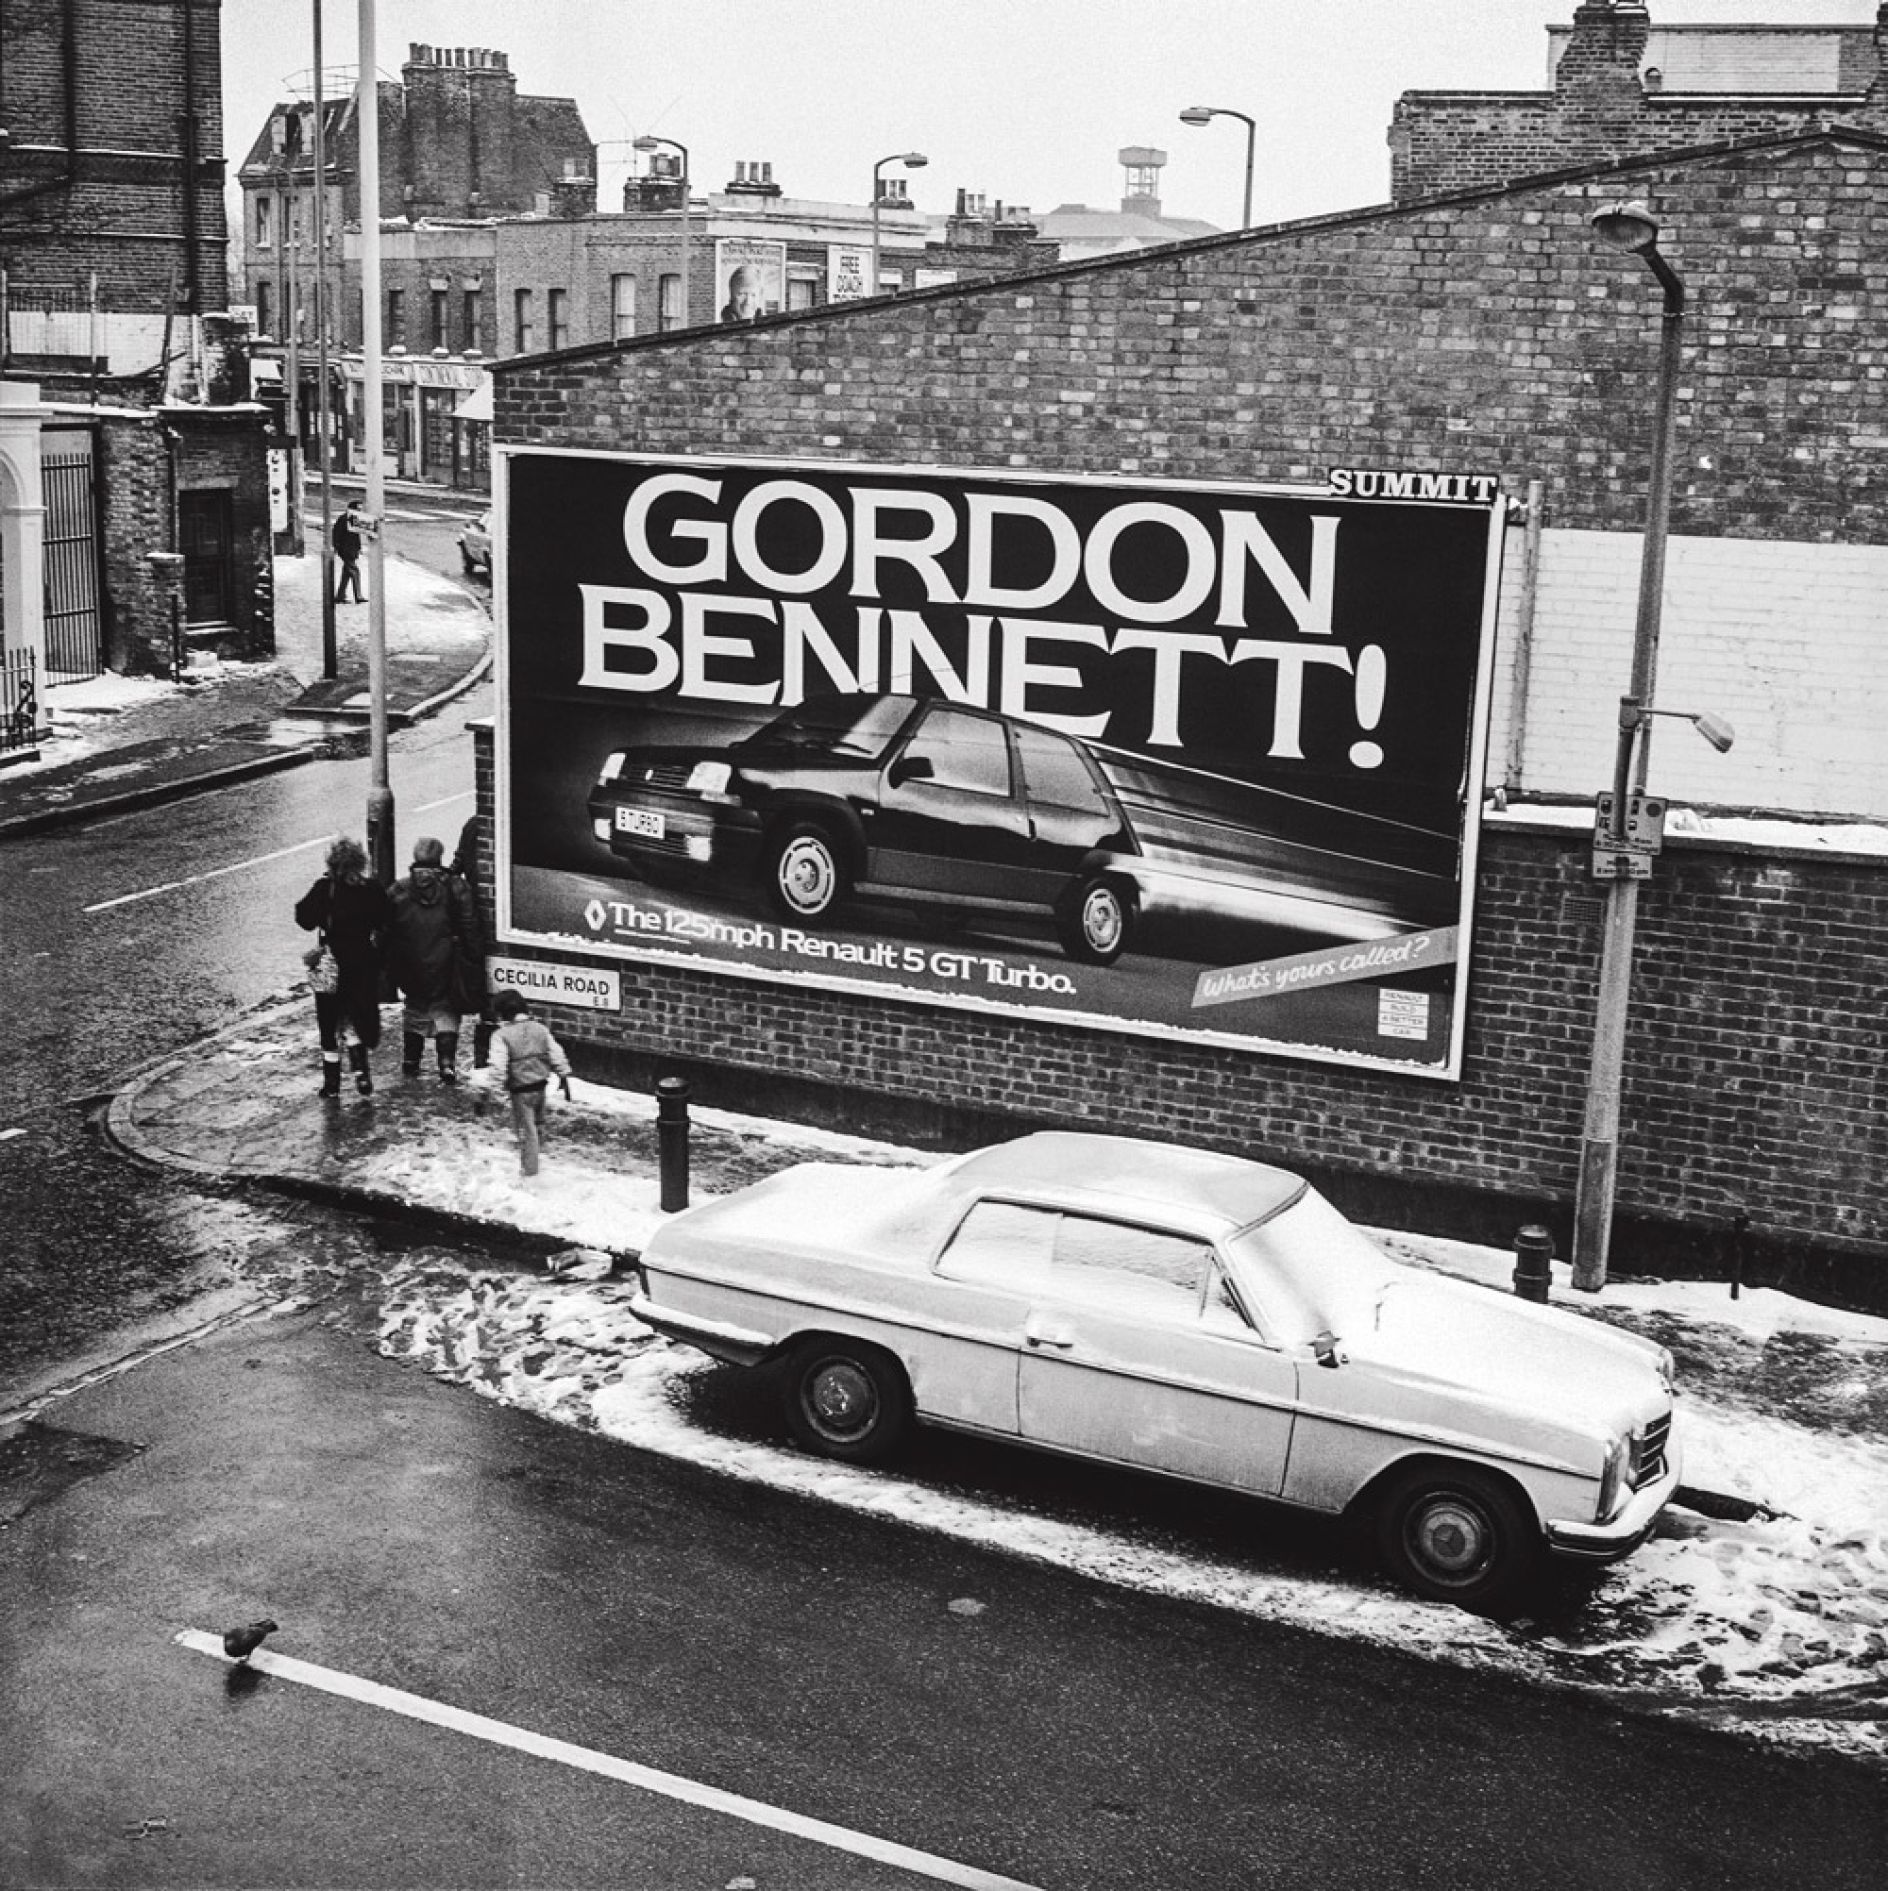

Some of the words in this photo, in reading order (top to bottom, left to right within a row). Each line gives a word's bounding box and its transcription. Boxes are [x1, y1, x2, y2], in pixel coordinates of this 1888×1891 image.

[1330, 470, 1497, 501] SUMMIT
[624, 474, 1340, 634] GORDON
[577, 584, 1387, 768] BENNETT!
[494, 967, 558, 989] CECILIA
[564, 976, 609, 996] ROAD
[608, 902, 661, 931] The
[664, 908, 775, 949] 125mph
[781, 928, 899, 969] Renault
[902, 947, 926, 973] 5
[930, 952, 978, 980] GT
[980, 958, 1077, 994] Turbo.
[1203, 966, 1271, 997] What's
[1275, 959, 1335, 989] yours
[1340, 935, 1430, 972] called?
